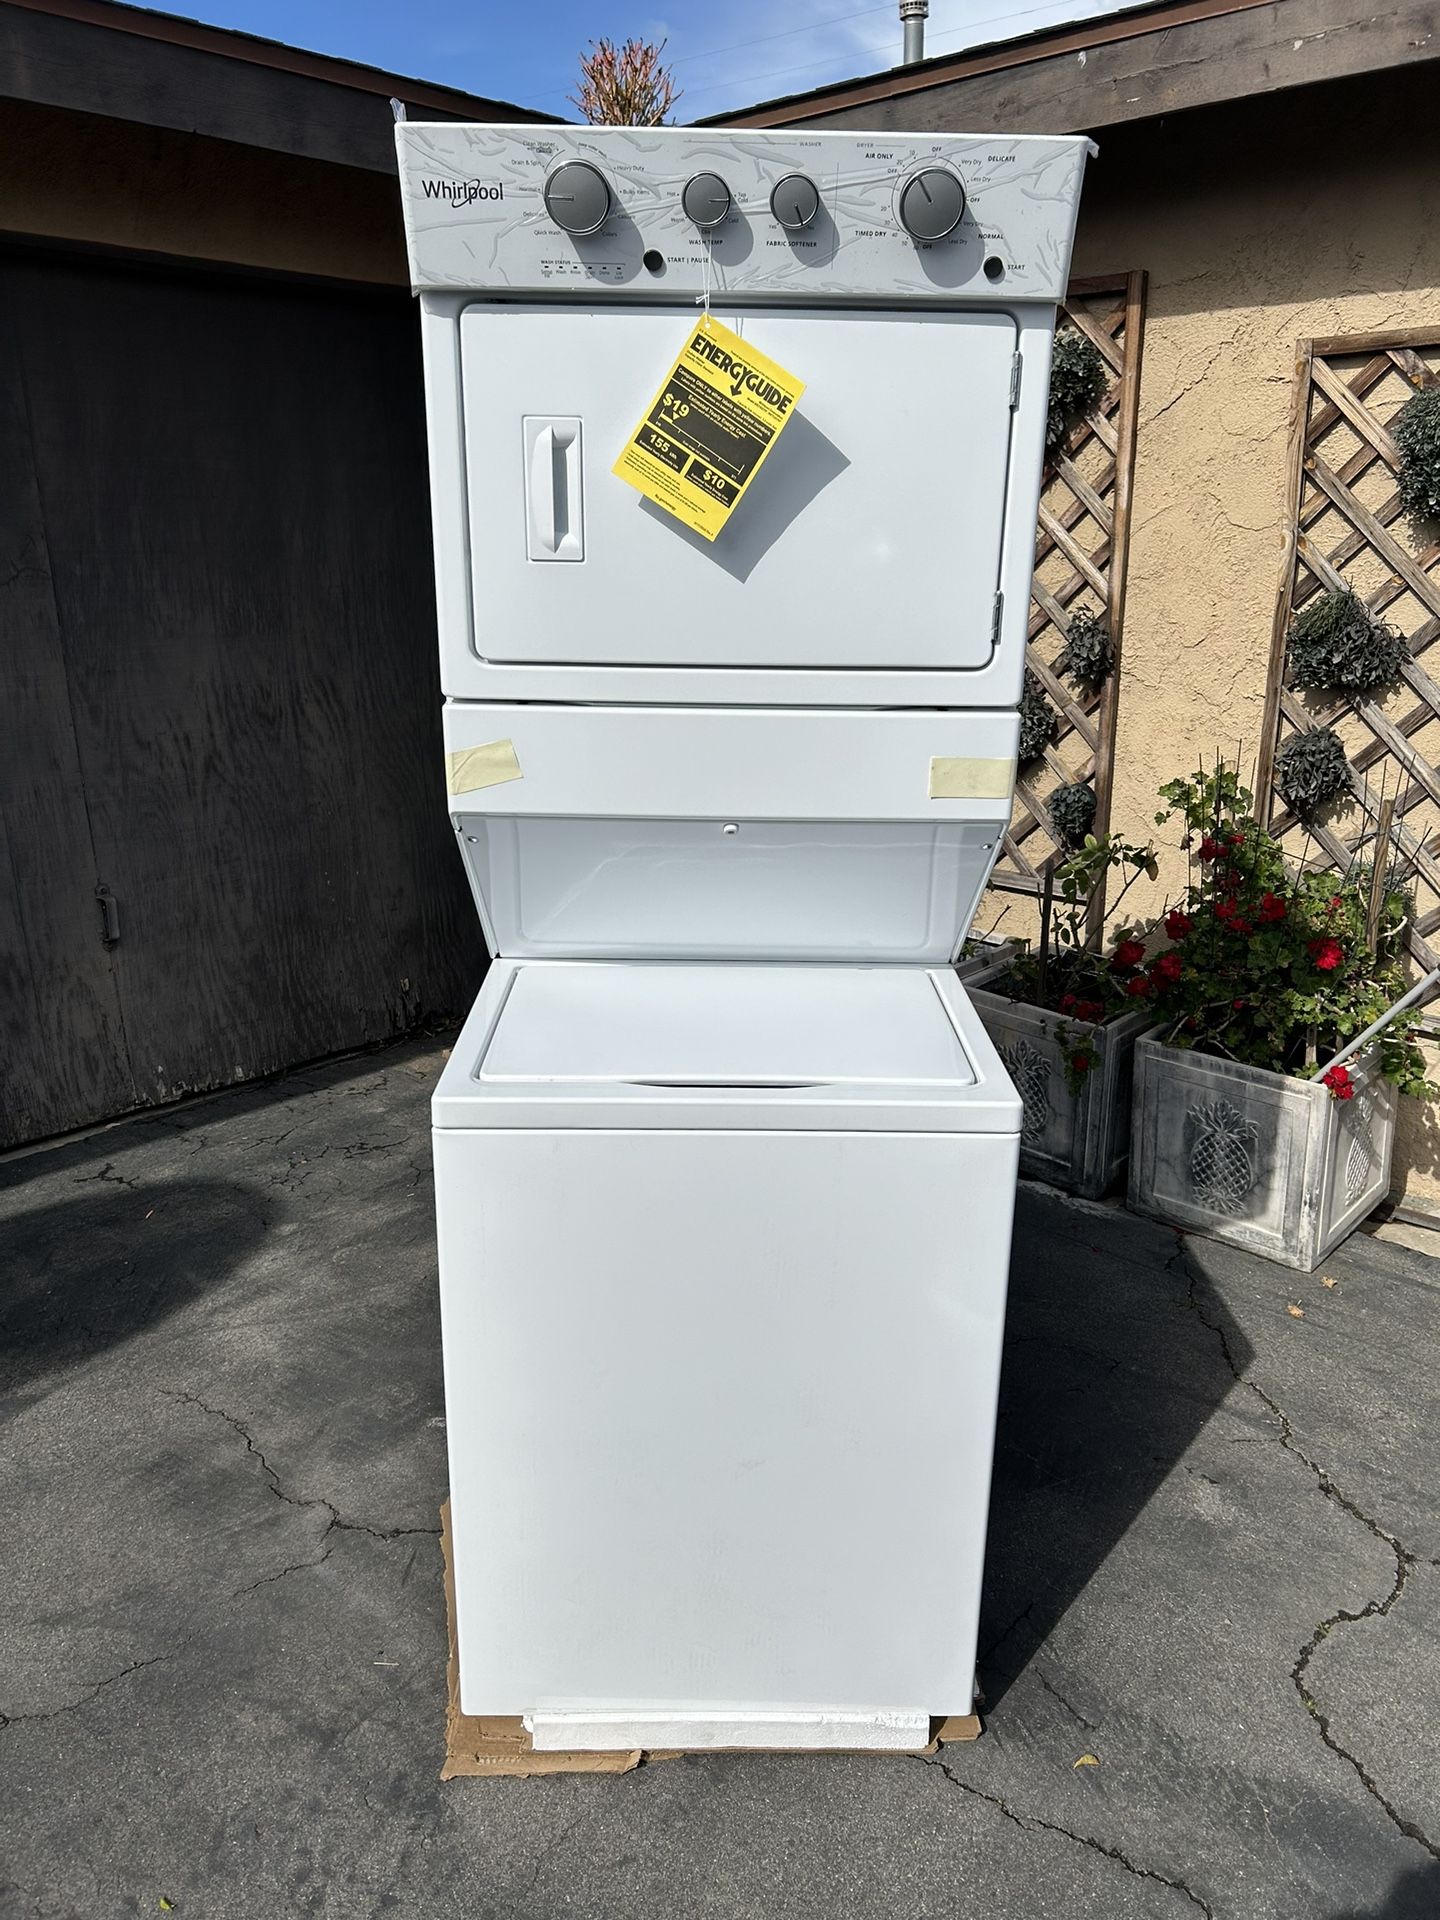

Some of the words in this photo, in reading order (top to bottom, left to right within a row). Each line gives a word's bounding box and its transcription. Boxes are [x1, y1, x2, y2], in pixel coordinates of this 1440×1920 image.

[987, 155, 1016, 163] DELICATE
[421, 178, 504, 209] Whirlpool
[874, 230, 887, 238] DRY
[689, 332, 792, 414] ENERGYGUIDE
[695, 379, 707, 390] ONLY
[660, 391, 691, 419] $19
[720, 417, 736, 431] Energy
[647, 432, 670, 453] 155
[701, 468, 726, 491] $10
